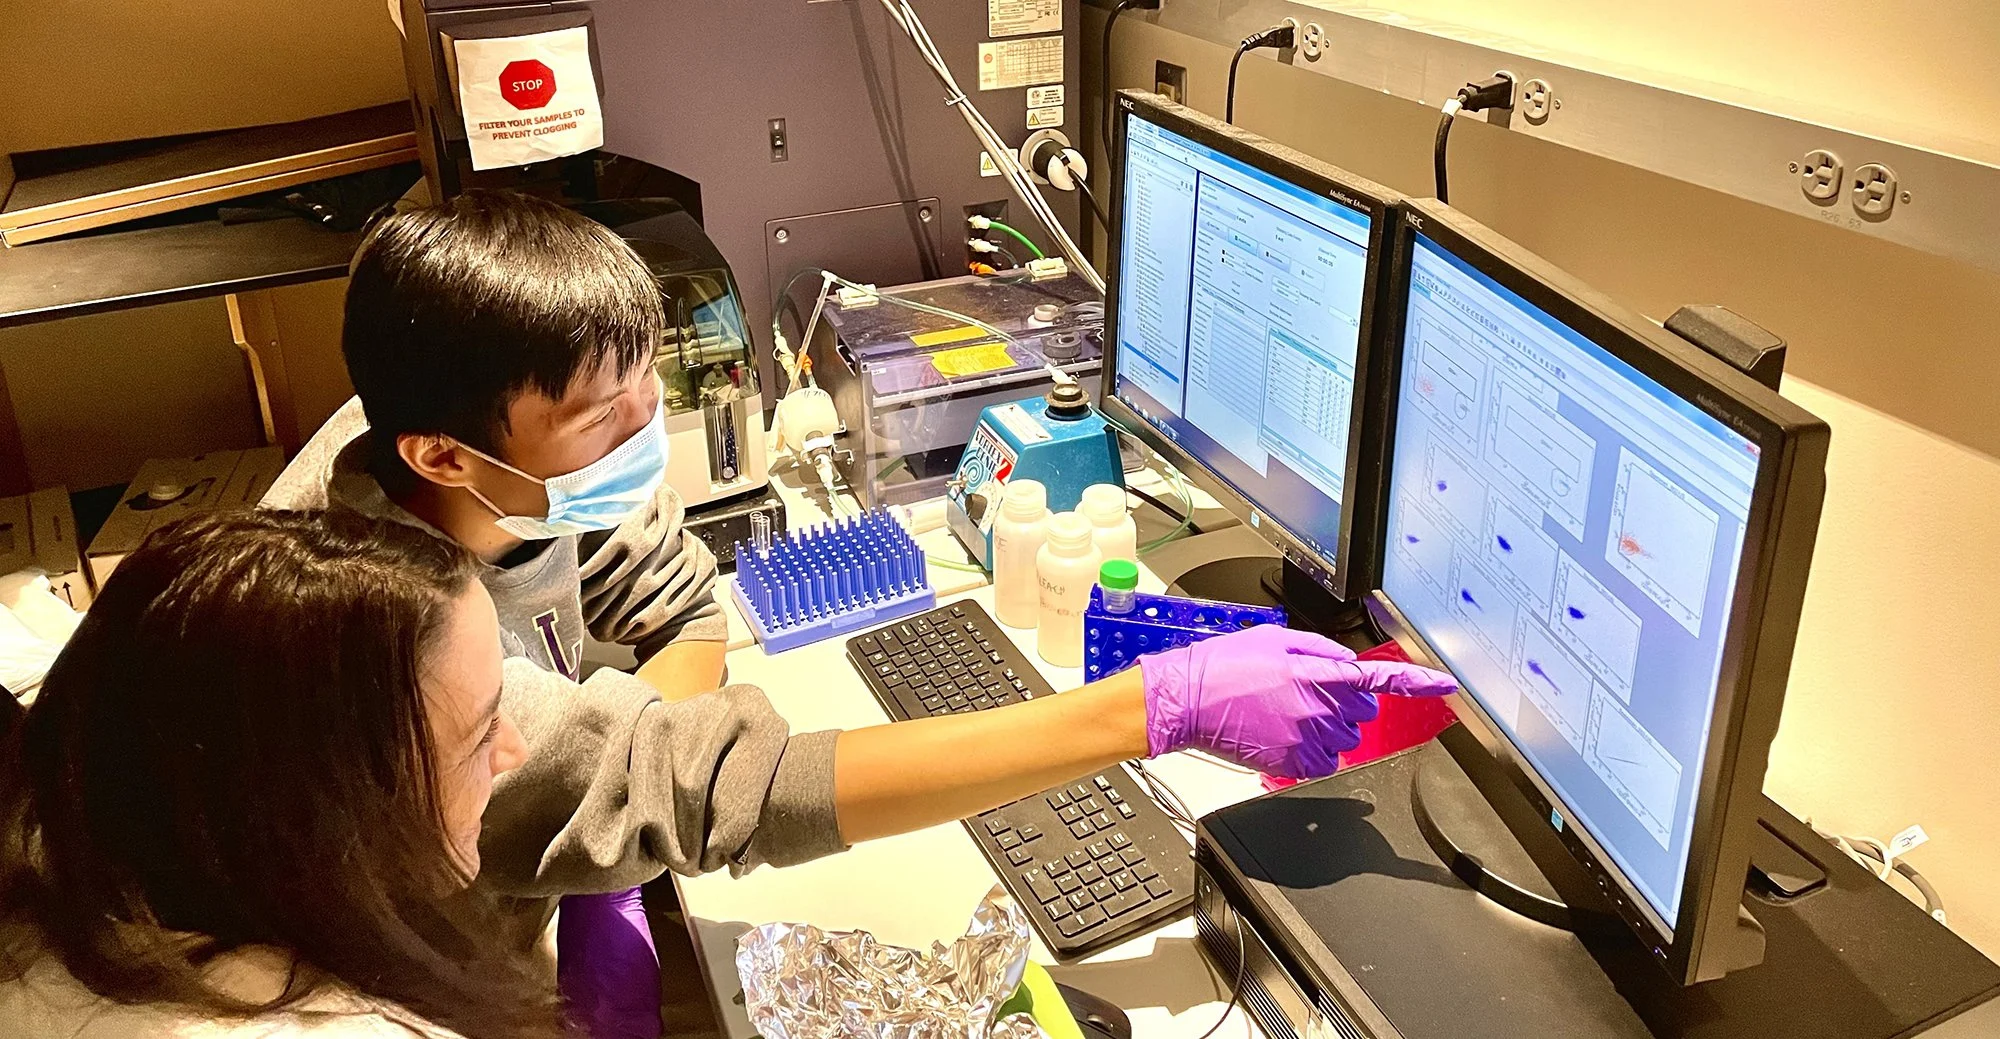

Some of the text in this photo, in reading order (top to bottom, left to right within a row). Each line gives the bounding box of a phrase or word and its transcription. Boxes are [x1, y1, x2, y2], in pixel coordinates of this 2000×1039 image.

[512, 79, 543, 92] STOP
[1120, 97, 1135, 111] NEC
[479, 108, 585, 130] FILTER YOUR SAMPLES TO
[492, 121, 577, 140] PREVENT CLOGGING
[1405, 211, 1424, 230] NEC
[975, 430, 1002, 464] VORTEX
